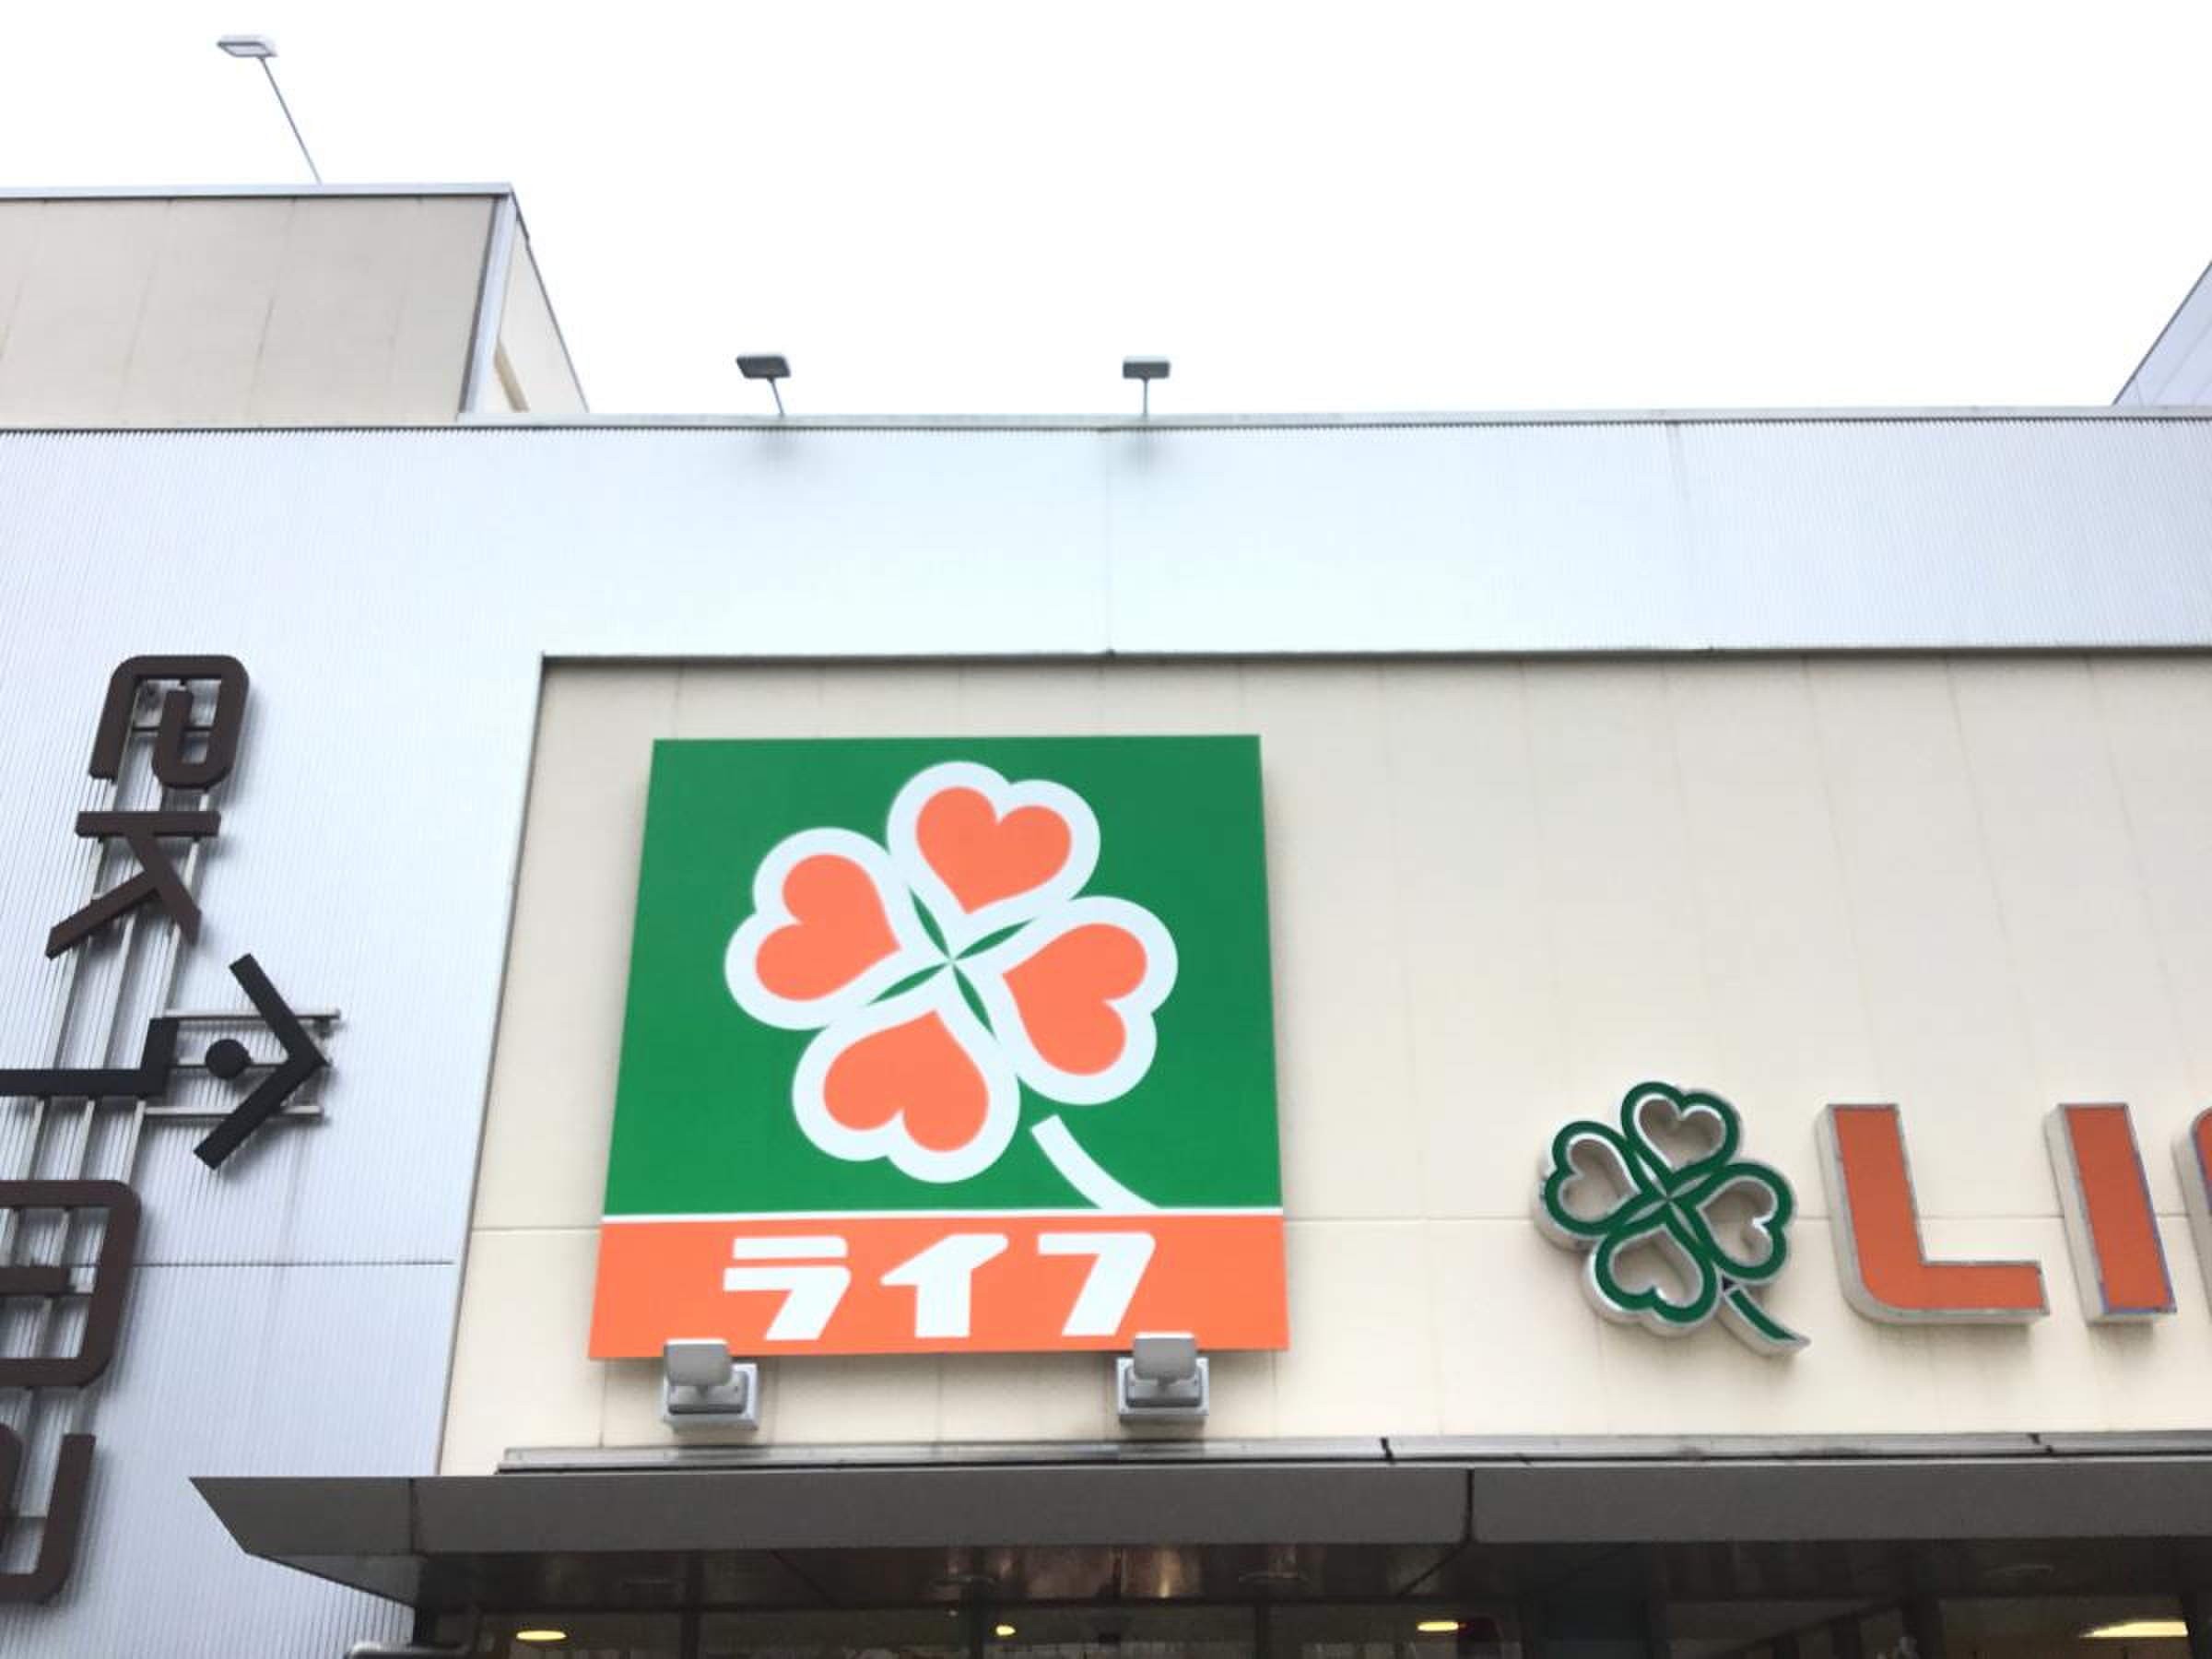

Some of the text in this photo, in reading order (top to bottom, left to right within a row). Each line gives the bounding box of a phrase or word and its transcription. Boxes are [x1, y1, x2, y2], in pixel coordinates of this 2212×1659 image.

[722, 1231, 1157, 1341] ライフ
[1819, 1103, 2212, 1318] LI
